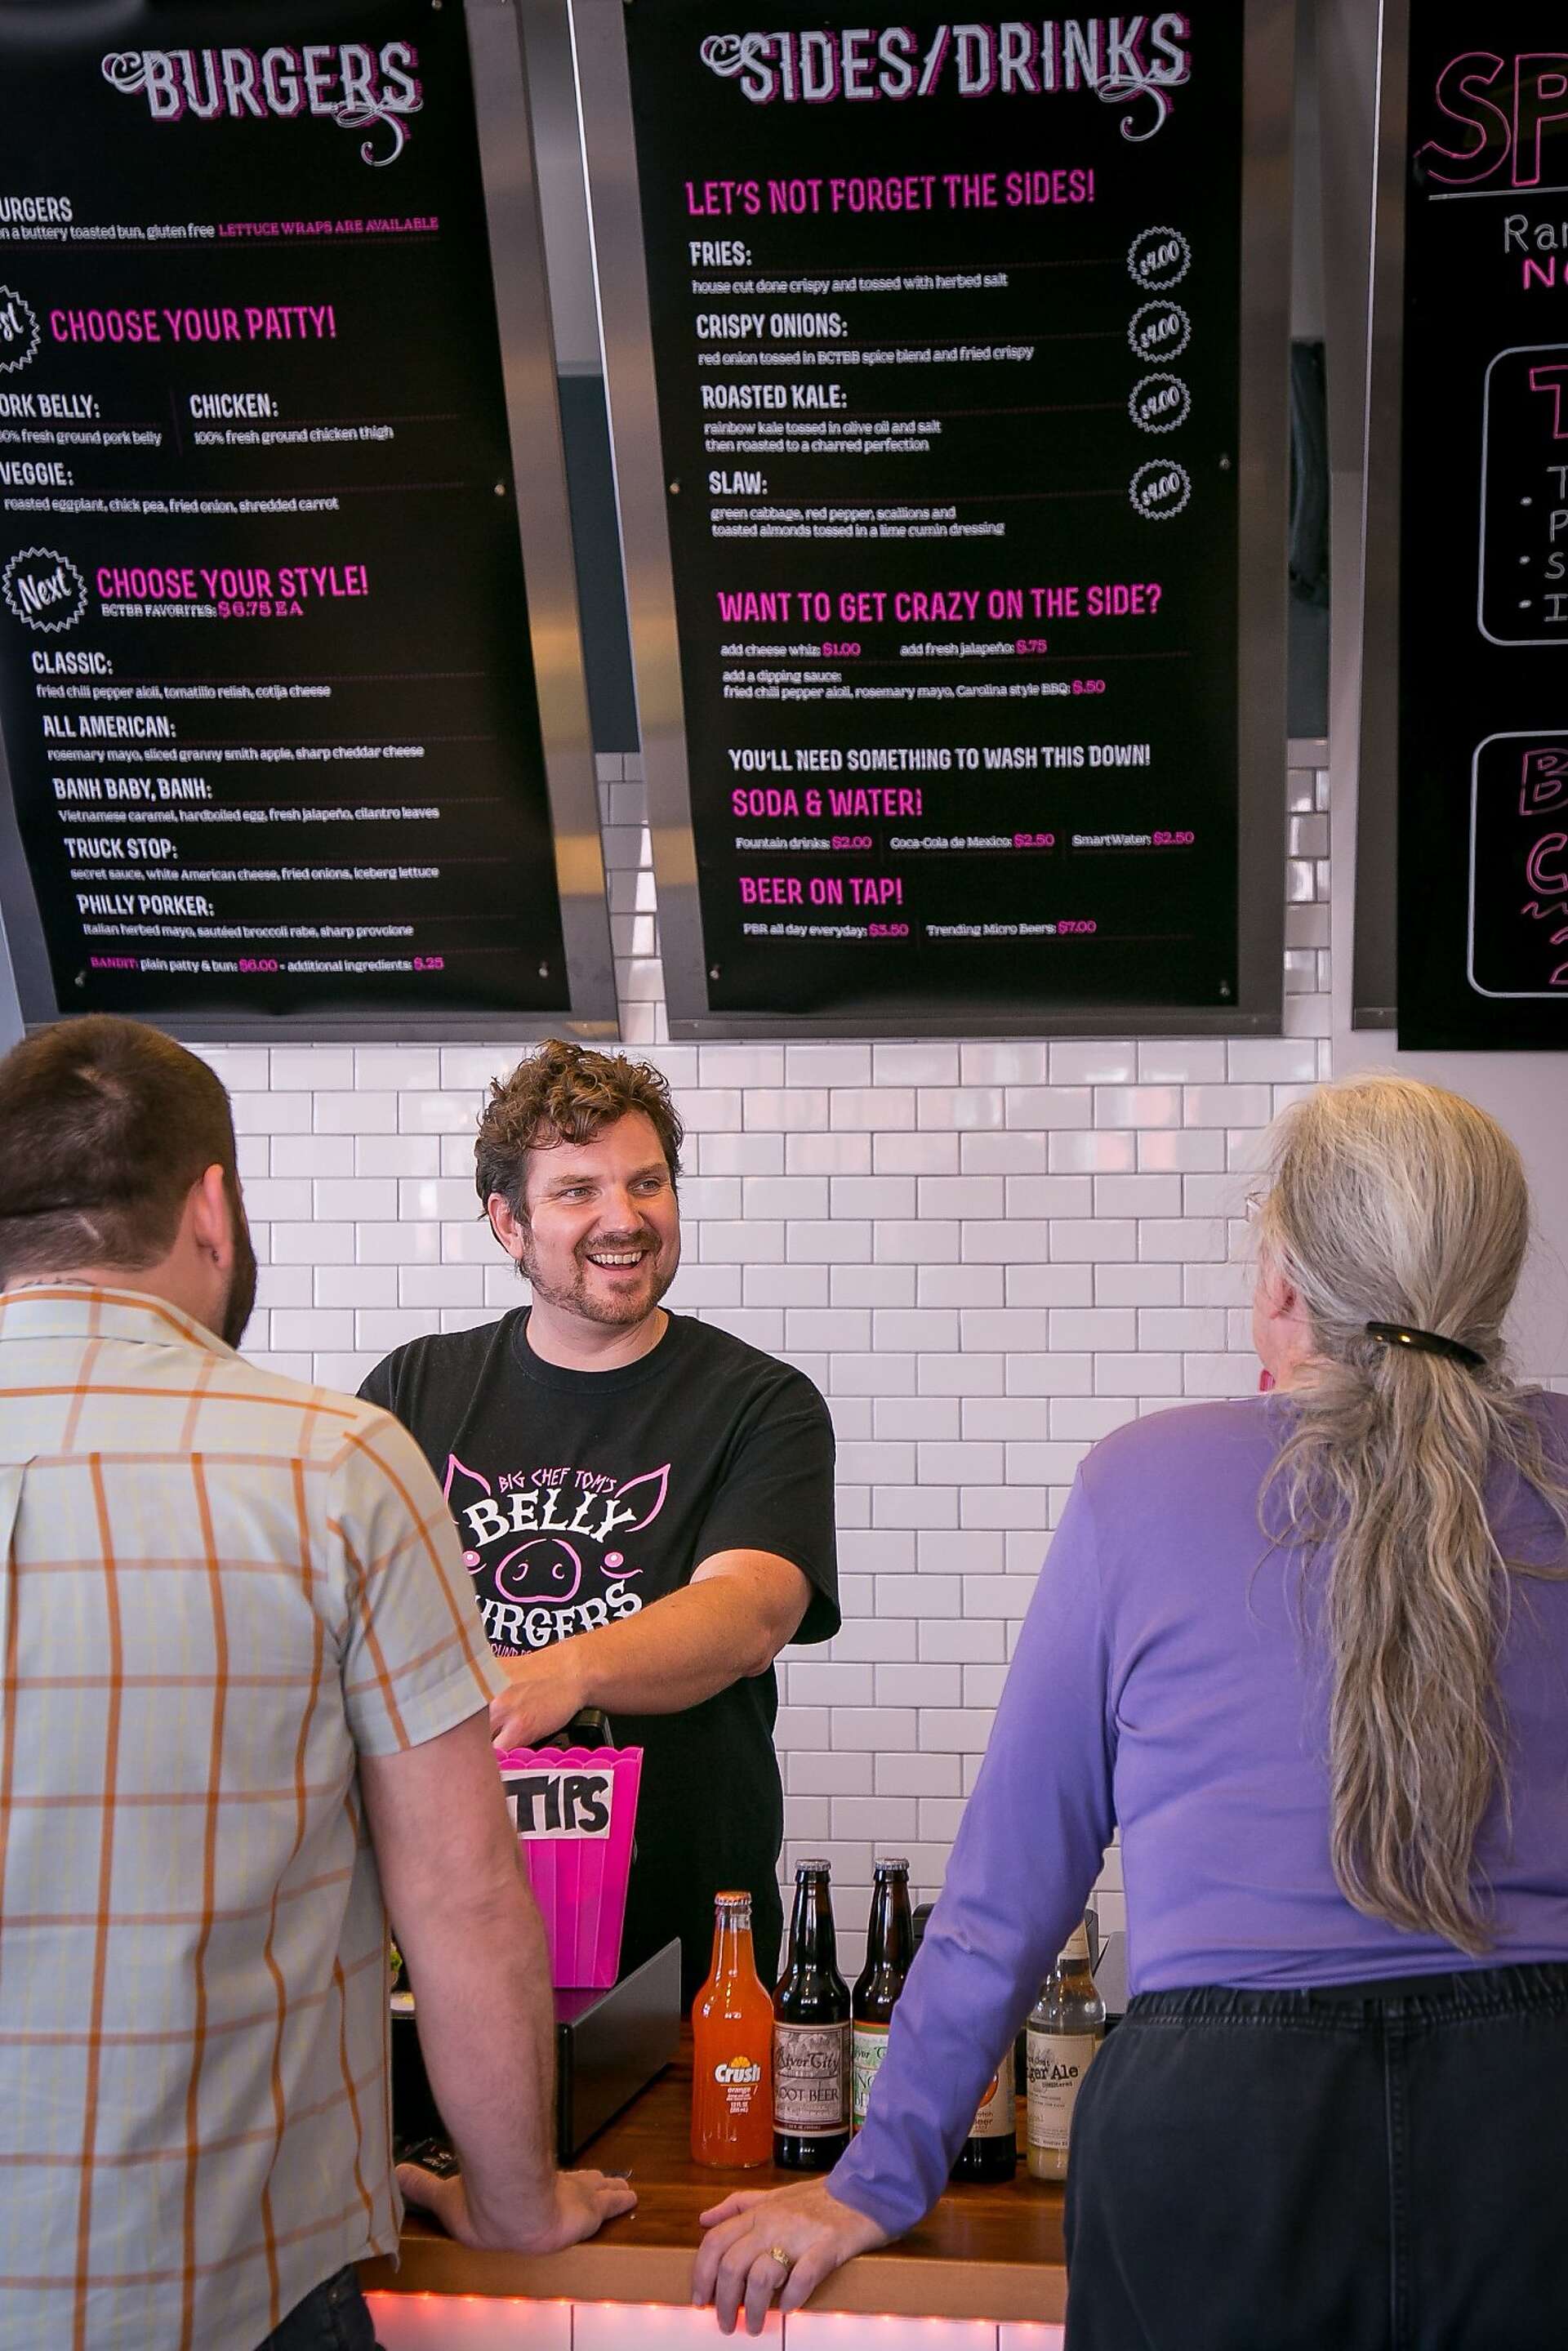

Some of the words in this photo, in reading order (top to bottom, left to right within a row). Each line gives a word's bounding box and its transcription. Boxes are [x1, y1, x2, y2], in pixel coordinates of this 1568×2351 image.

[701, 12, 1191, 135] SIDES/DRINKS
[102, 41, 423, 157] BURGERS
[686, 179, 760, 215] LET'S
[768, 179, 822, 214] NOT
[830, 174, 938, 212] FORGET
[943, 172, 997, 209] THE
[1005, 168, 1095, 207] SIDES!
[11, 227, 20, 239] a
[20, 225, 69, 242] buttery
[69, 225, 116, 239] toasted
[146, 224, 187, 241] gluten
[188, 223, 215, 238] free
[218, 222, 279, 237] LETTUCE
[281, 220, 332, 235] WRAPS
[335, 219, 363, 234] ARE
[365, 216, 439, 233] AVAILABLE
[688, 240, 752, 266] FRIES:
[692, 280, 731, 294] house
[732, 279, 755, 294] cut
[755, 278, 788, 294] done
[789, 278, 830, 296] crispy
[831, 278, 857, 292] and
[858, 276, 902, 292] tossed
[902, 275, 933, 290] with
[935, 274, 982, 289] herbed
[983, 272, 1009, 287] salt
[50, 308, 162, 343] CHOOSE
[163, 308, 243, 342] YOUR
[244, 304, 337, 341] PATTY!
[696, 313, 766, 339] CRISPY
[769, 312, 849, 339] ONIONS:
[37, 393, 100, 419] BELLY:
[190, 393, 279, 419] CHICKEN:
[700, 385, 787, 408] ROASTED
[790, 385, 847, 408] KALE:
[21, 429, 55, 443] fresh
[56, 430, 101, 445] ground
[103, 430, 131, 446] pork
[131, 431, 163, 447] belly
[225, 429, 260, 444] fresh
[261, 428, 308, 445] ground
[310, 426, 358, 443] chicken
[359, 425, 394, 441] thigh
[705, 439, 736, 452] then
[736, 439, 784, 452] roasted
[785, 439, 800, 452] to
[800, 440, 809, 452] a
[810, 439, 862, 452] charred
[863, 437, 930, 455] perfection
[0, 461, 74, 486] VEGGIE:
[708, 470, 768, 495] SLAW:
[17, 567, 73, 613] Next
[96, 567, 198, 599] CHOOSE
[200, 568, 274, 599] YOUR
[278, 563, 368, 599] STYLE!
[275, 601, 305, 617] EA
[717, 591, 792, 623] WANT
[797, 591, 832, 623] TO
[838, 590, 888, 623] GET
[895, 589, 980, 622] CRAZY
[986, 588, 1024, 620] ON
[1030, 586, 1080, 619] THE
[1085, 582, 1163, 617] SIDE?
[720, 643, 743, 657] add
[744, 643, 787, 657] cheese
[899, 643, 924, 657] add
[924, 642, 960, 657] fresh
[32, 651, 114, 675] CLASSIC:
[42, 715, 77, 738] ALL
[78, 715, 176, 738] AMERICAN:
[728, 748, 794, 772] YOU'LL
[795, 748, 843, 772] NEED
[846, 747, 952, 772] SOMETHING
[954, 747, 979, 770] TO
[982, 746, 1039, 770] WASH
[1040, 745, 1085, 769] THIS
[1087, 743, 1151, 768] DOWN!
[52, 777, 102, 799] BANH
[103, 777, 157, 802] BABY,
[156, 777, 213, 799] BANH:
[731, 787, 800, 817] SODA
[804, 787, 822, 817] &
[828, 786, 923, 817] WATER!
[64, 838, 125, 859] TRUCK
[127, 838, 179, 859] STOP:
[735, 836, 788, 850] Fountain
[949, 835, 965, 849] de
[70, 867, 108, 880] secret
[146, 867, 179, 881] white
[180, 867, 236, 882] American
[281, 867, 310, 880] fried
[353, 866, 399, 880] iceberg
[398, 866, 440, 879] lettuce
[738, 877, 804, 905] BEER
[809, 877, 844, 906] ON
[848, 877, 903, 906] TAP!
[76, 893, 136, 915] PHILLY
[137, 894, 216, 917] PORKER:
[769, 923, 785, 935] all
[785, 923, 808, 937] day
[926, 924, 982, 937] Trending
[982, 922, 1018, 936] Micro
[498, 1470, 526, 1494] BIG
[531, 1467, 571, 1487] CHEF
[574, 1470, 618, 1494] TOM'S
[462, 1487, 637, 1548] BELLY
[505, 1775, 609, 1832] TIPS
[714, 2063, 761, 2083] Crush
[1050, 2064, 1079, 2081] Ale
[808, 2088, 839, 2103] BEER
